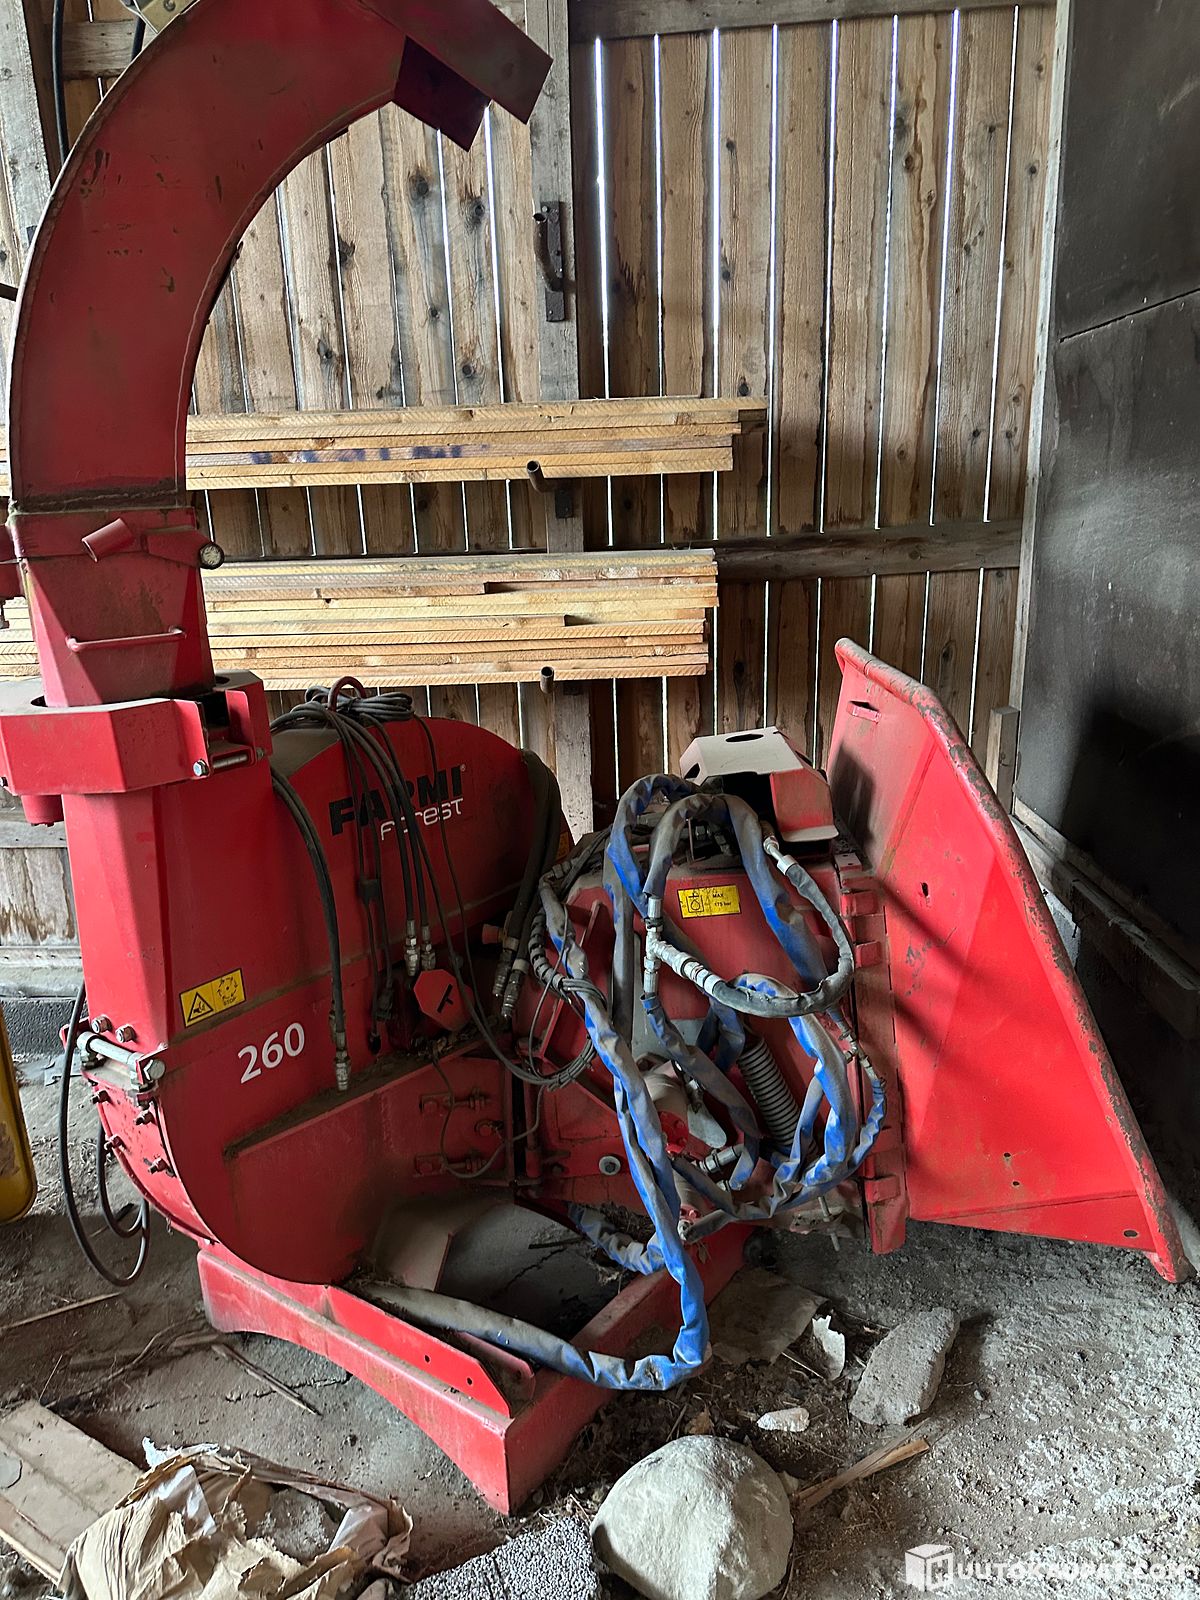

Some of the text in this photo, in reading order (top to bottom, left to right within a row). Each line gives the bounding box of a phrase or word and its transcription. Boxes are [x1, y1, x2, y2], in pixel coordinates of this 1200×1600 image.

[328, 765, 463, 836] FARMI
[380, 797, 464, 840] Fest
[223, 996, 237, 1006] STOP
[237, 1022, 305, 1084] 260
